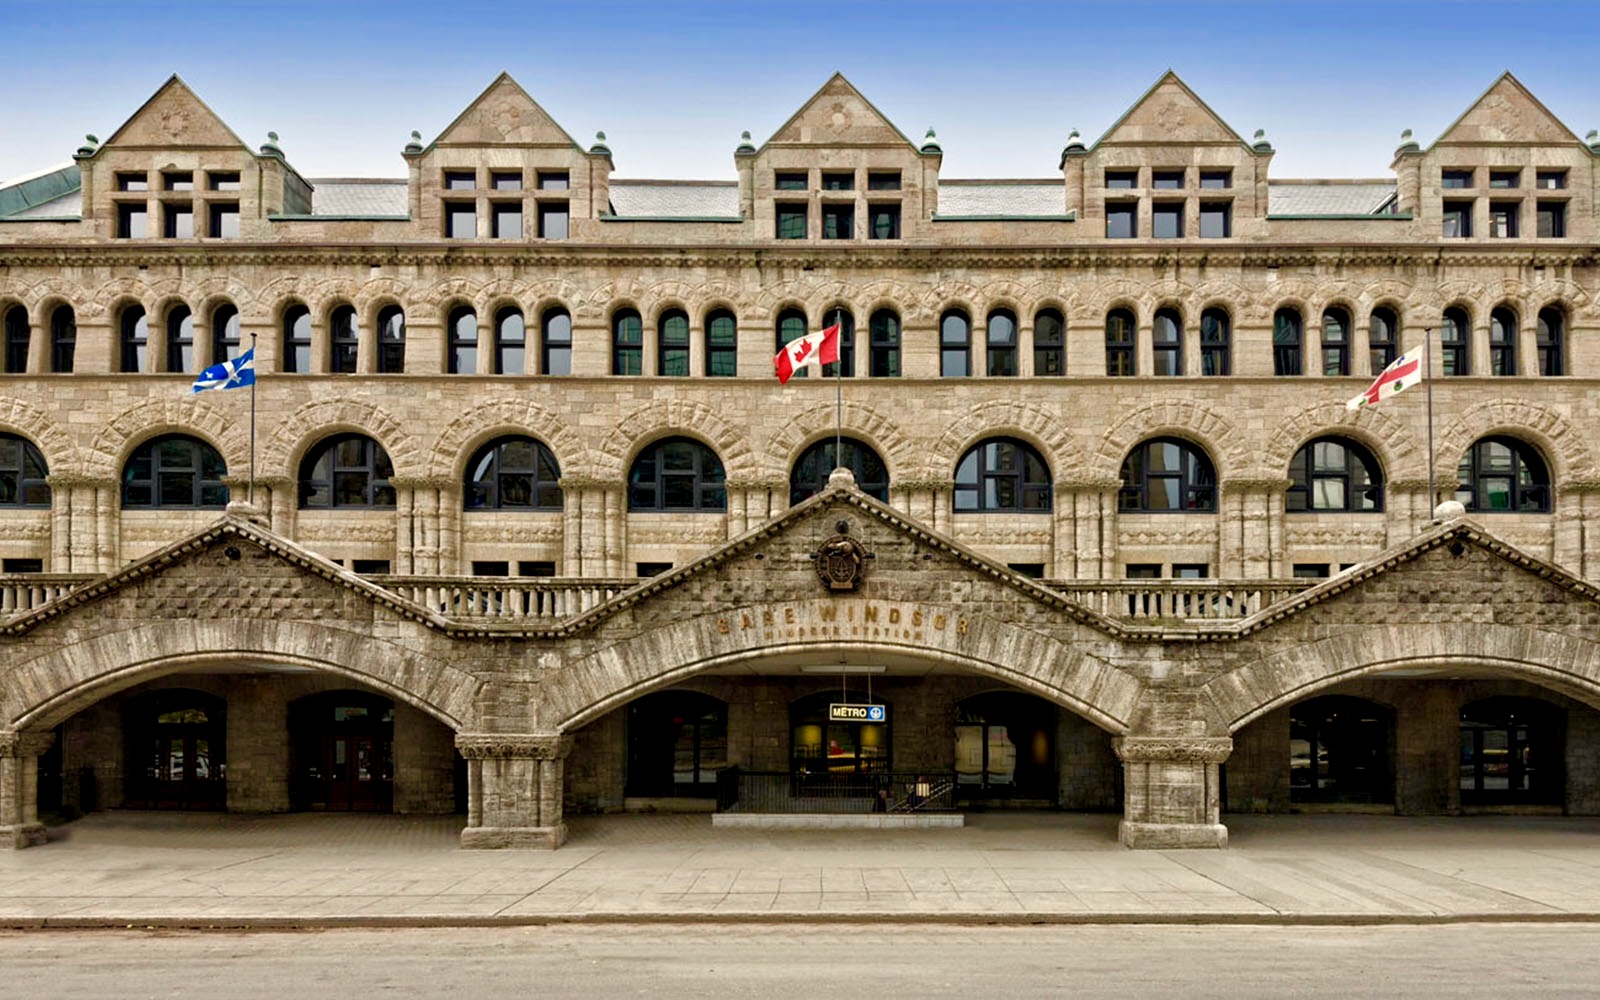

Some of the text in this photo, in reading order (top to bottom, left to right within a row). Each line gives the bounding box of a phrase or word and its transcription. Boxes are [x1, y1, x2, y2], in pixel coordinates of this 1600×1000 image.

[717, 605, 968, 636] GARE WINDSOR
[763, 626, 923, 640] WINDSOR STATION
